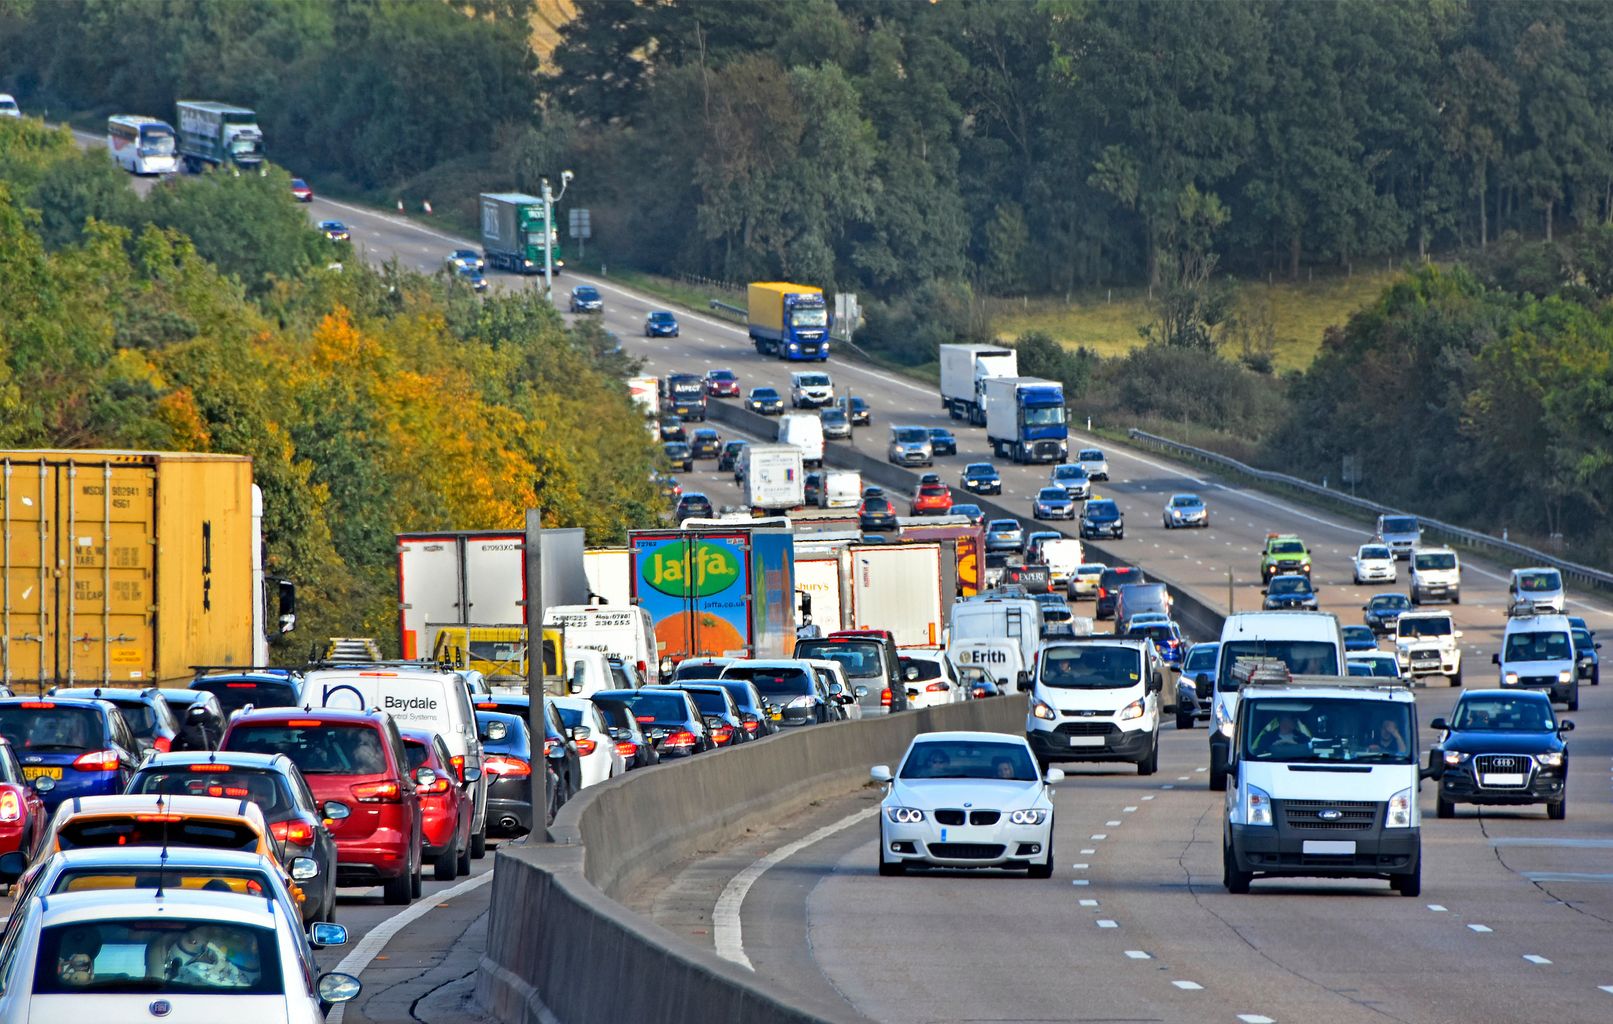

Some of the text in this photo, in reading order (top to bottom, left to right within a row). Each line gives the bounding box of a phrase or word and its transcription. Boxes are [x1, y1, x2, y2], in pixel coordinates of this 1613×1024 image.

[675, 384, 701, 392] ASPECT
[653, 546, 728, 588] Jaffa
[972, 650, 1006, 663] Erith
[385, 696, 437, 711] Baydale
